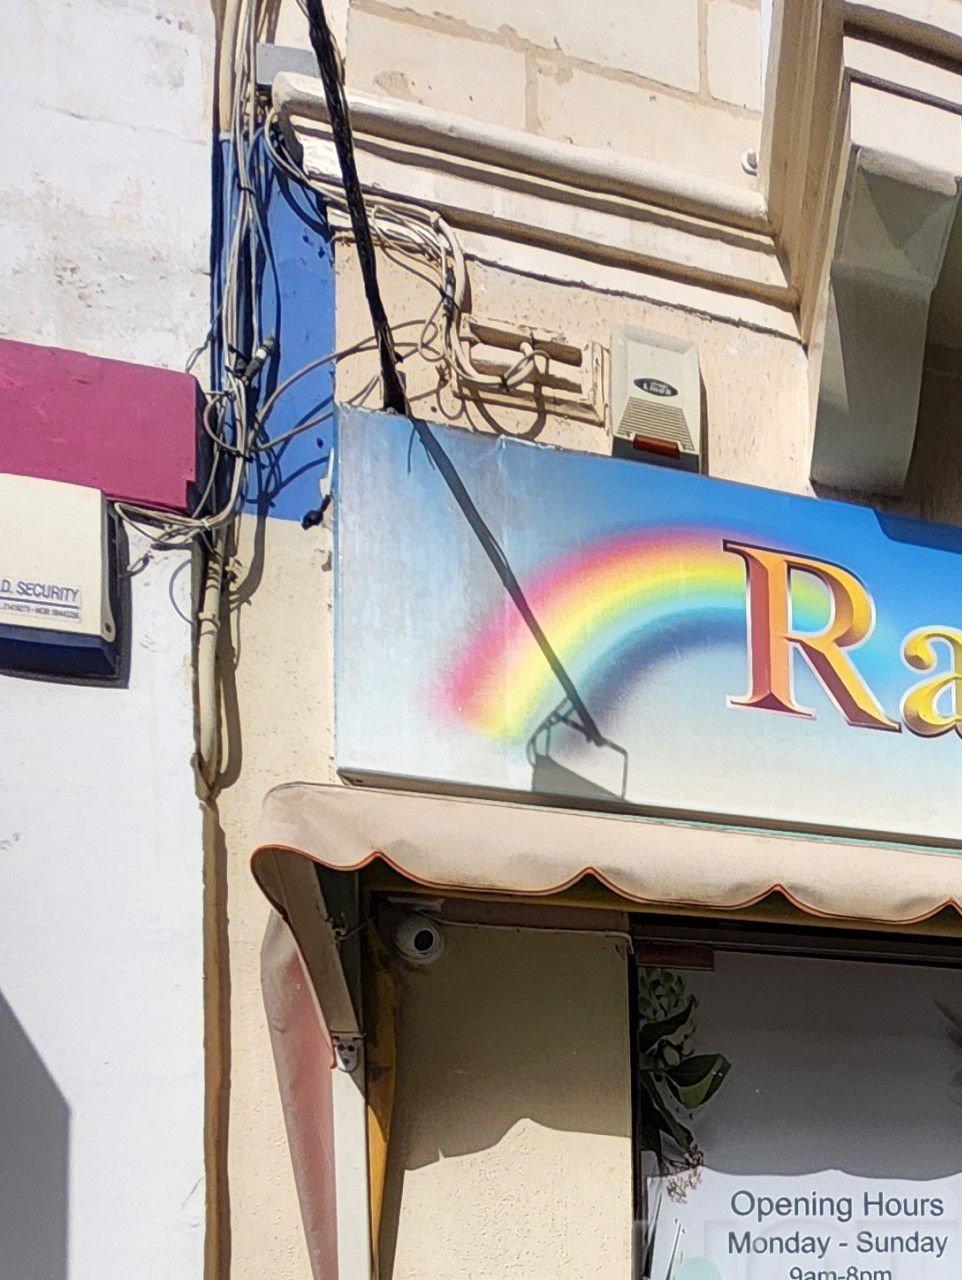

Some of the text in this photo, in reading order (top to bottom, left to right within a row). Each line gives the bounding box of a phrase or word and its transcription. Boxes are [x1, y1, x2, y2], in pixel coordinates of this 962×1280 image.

[17, 581, 79, 601] SECURITY
[730, 1189, 945, 1222] Opening Hours
[727, 1231, 831, 1258] Monday
[856, 1230, 948, 1258] Sunday
